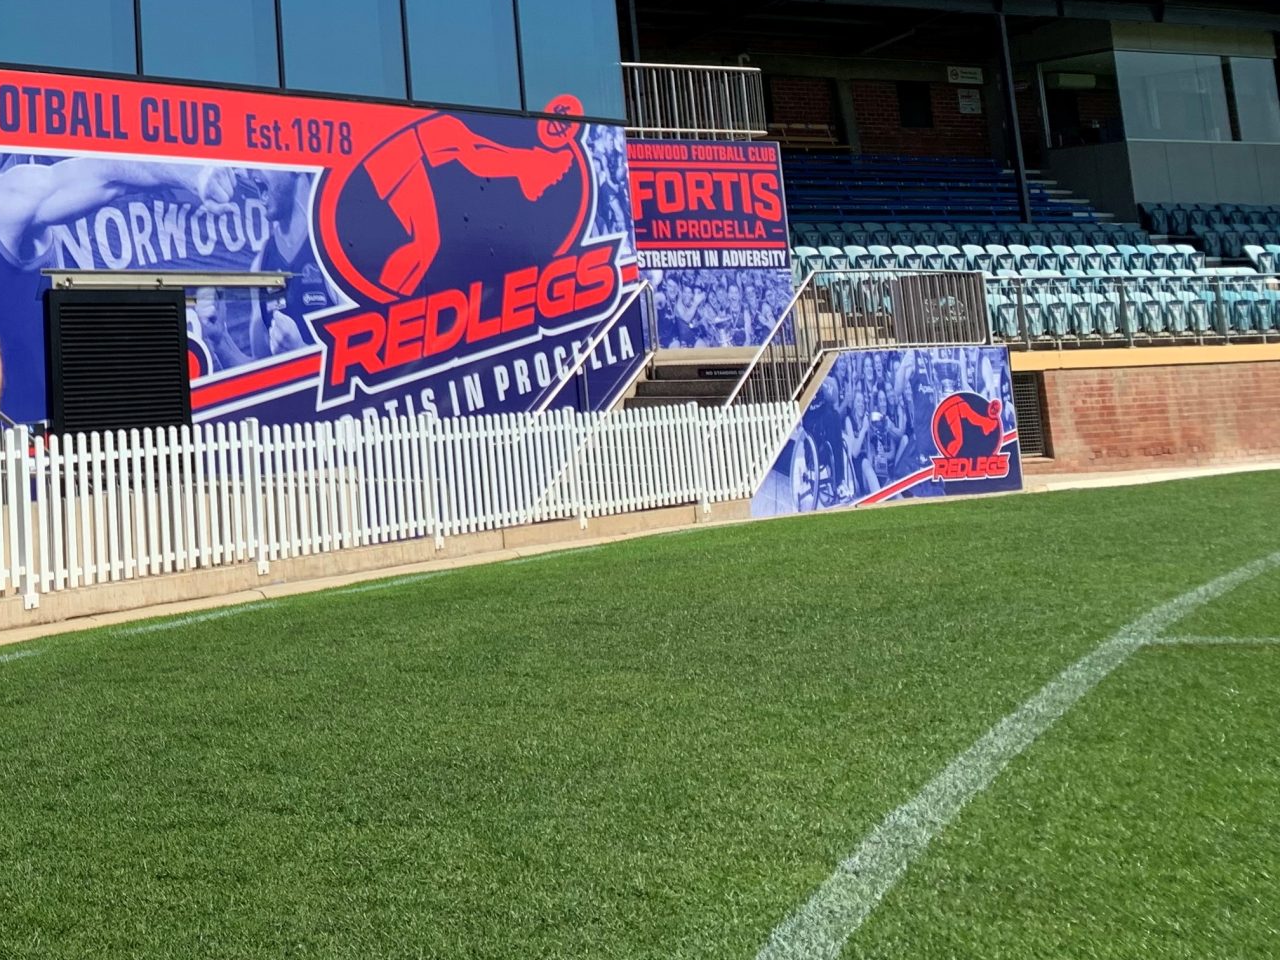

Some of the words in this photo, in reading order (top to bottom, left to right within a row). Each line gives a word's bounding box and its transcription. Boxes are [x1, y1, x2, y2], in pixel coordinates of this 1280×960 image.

[140, 97, 222, 146] CLUB
[627, 144, 688, 160] NORWOOD
[692, 145, 745, 161] FOOTBALL
[748, 146, 776, 162] CLUB
[629, 171, 782, 222] FORTIS
[51, 199, 270, 270] NORWOOD
[652, 220, 671, 239] IN
[676, 220, 767, 239] PROCELLA
[637, 250, 700, 268] STRENGTH
[705, 250, 719, 267] IN
[722, 250, 786, 267] ADVERSITY
[324, 246, 615, 386] REDLEGS
[449, 373, 485, 416] IN
[494, 326, 634, 402] PROCELLA
[933, 455, 1008, 480] REDLEGS
